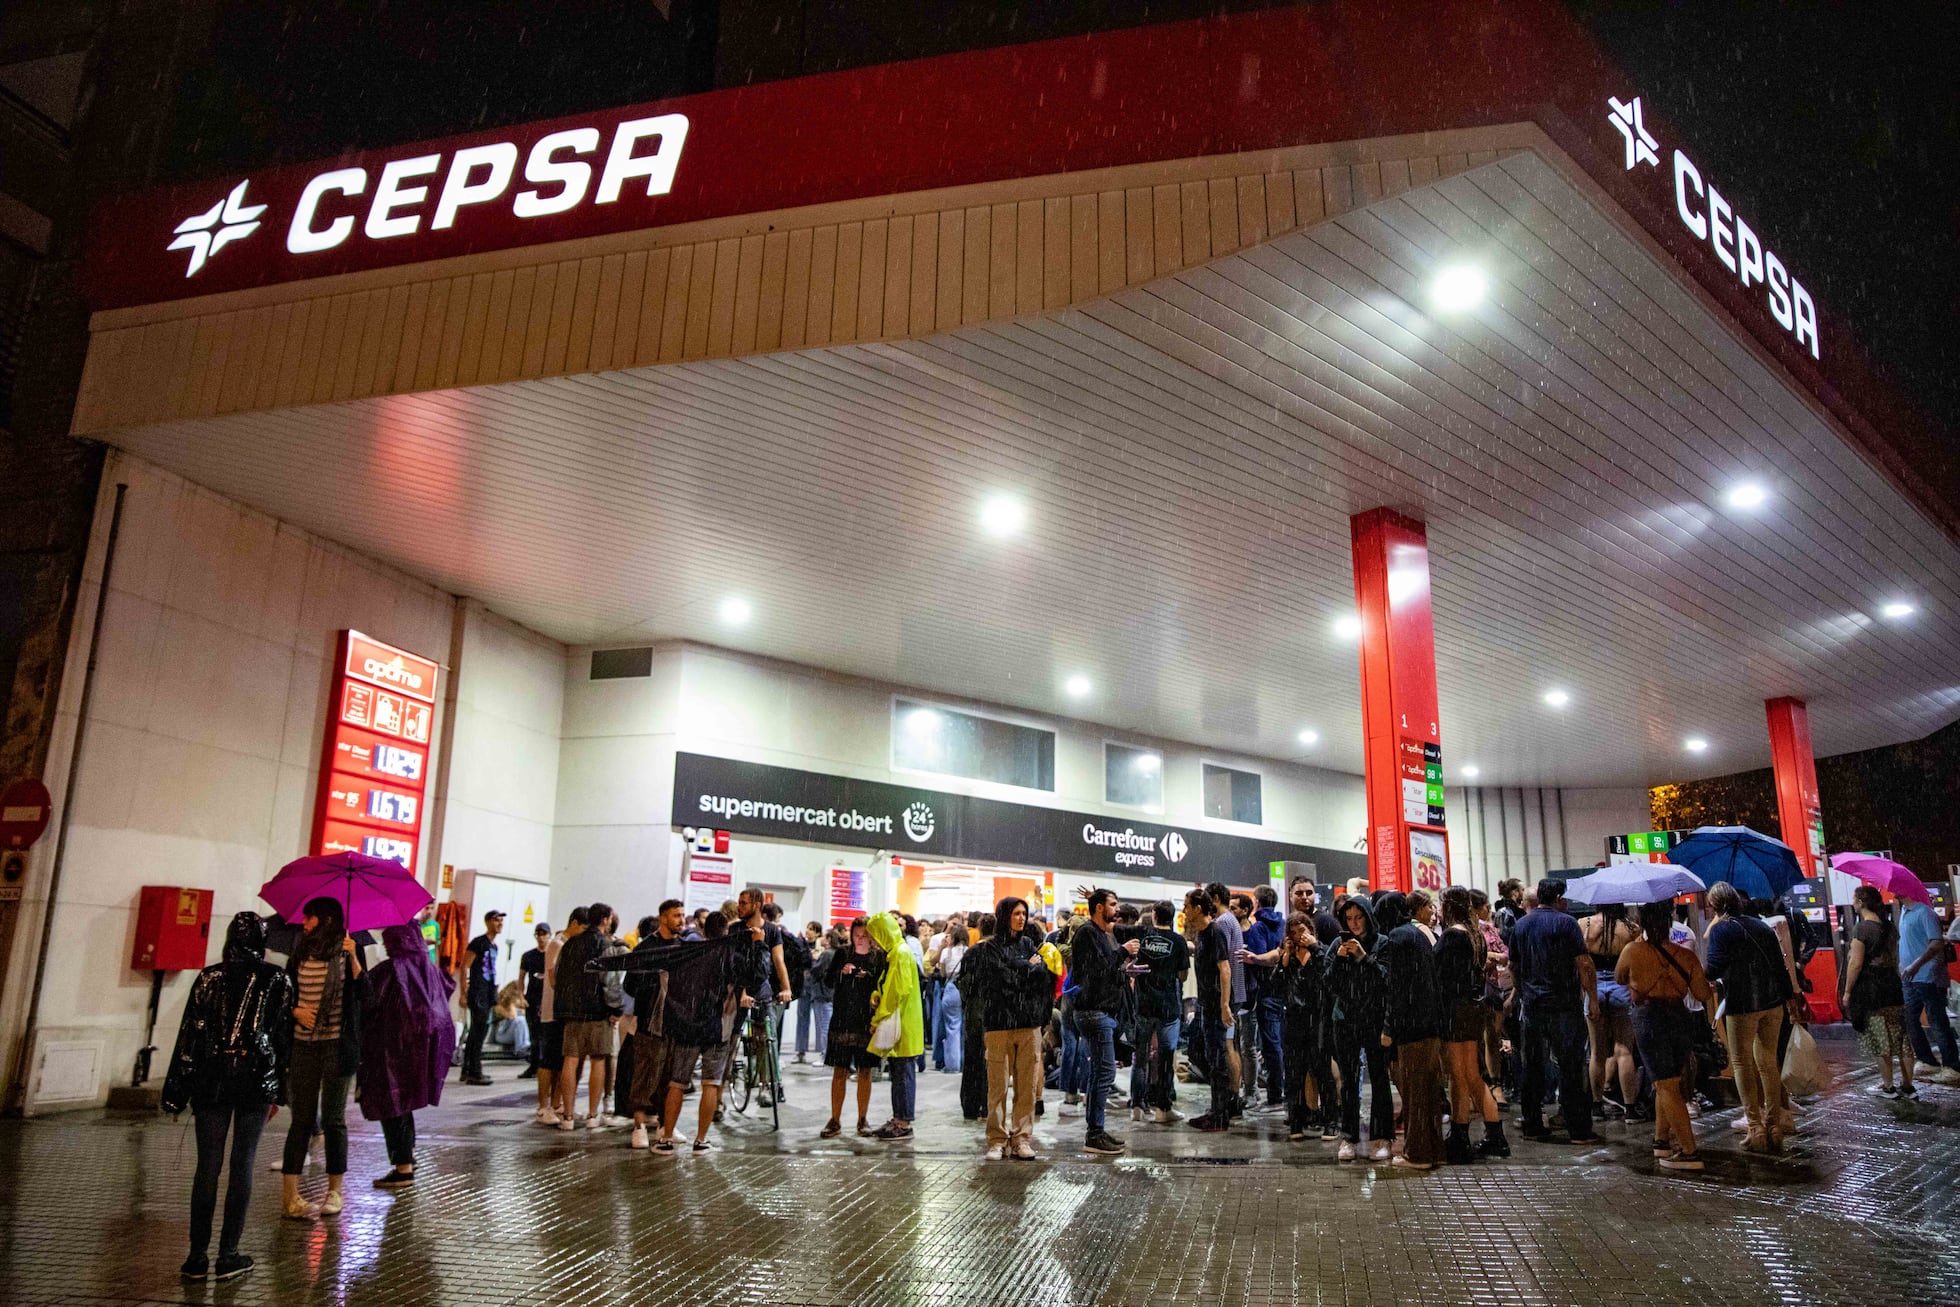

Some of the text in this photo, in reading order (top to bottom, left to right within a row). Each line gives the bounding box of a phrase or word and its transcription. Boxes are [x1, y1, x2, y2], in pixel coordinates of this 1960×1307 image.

[286, 113, 690, 255] CEPSA
[1673, 149, 1820, 361] CEPSA
[1401, 713, 1408, 728] 1
[1430, 721, 1437, 737] 3
[1426, 768, 1436, 780] 98
[1428, 789, 1438, 801] 95
[699, 794, 894, 834] supermercat obert
[912, 810, 927, 824] 24
[1082, 823, 1157, 852] Carrefour
[1634, 838, 1643, 850] 95
[1653, 836, 1662, 848] 98
[1115, 851, 1155, 868] express
[1417, 860, 1440, 891] 30
